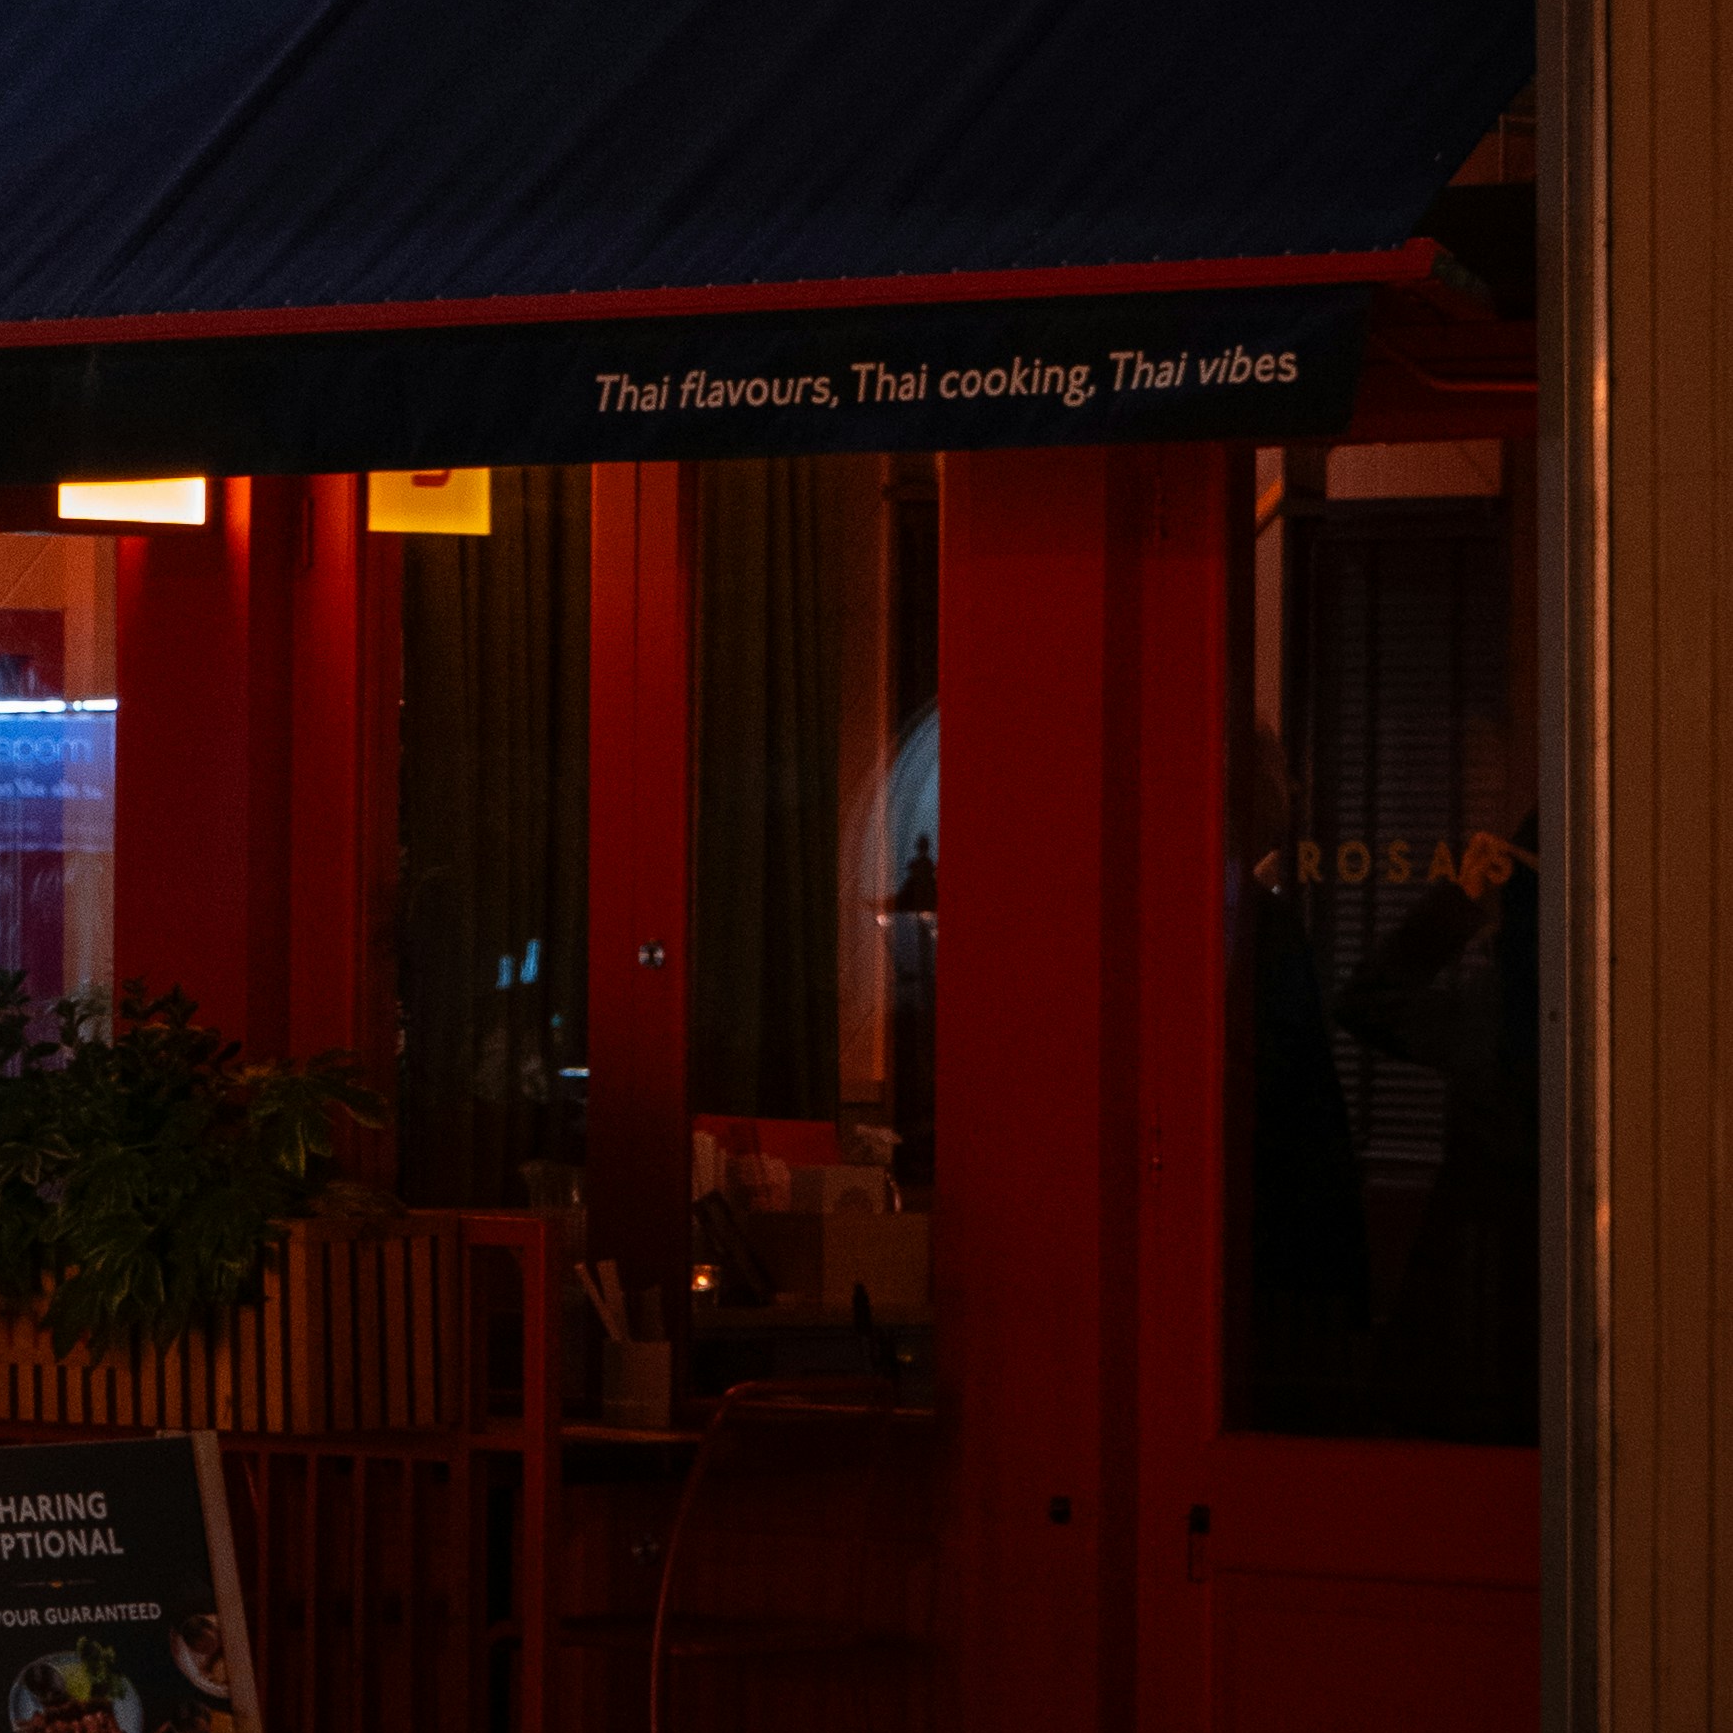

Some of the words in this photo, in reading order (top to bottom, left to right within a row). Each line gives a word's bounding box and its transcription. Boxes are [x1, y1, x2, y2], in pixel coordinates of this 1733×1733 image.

[594, 373, 670, 413] Thai
[678, 369, 840, 410] flavours,
[850, 361, 928, 404] Thai
[938, 355, 1097, 409] cooking,
[1108, 350, 1188, 392] Thai
[1198, 344, 1299, 385] vibes
[44, 1601, 162, 1626] GUARANTEED
